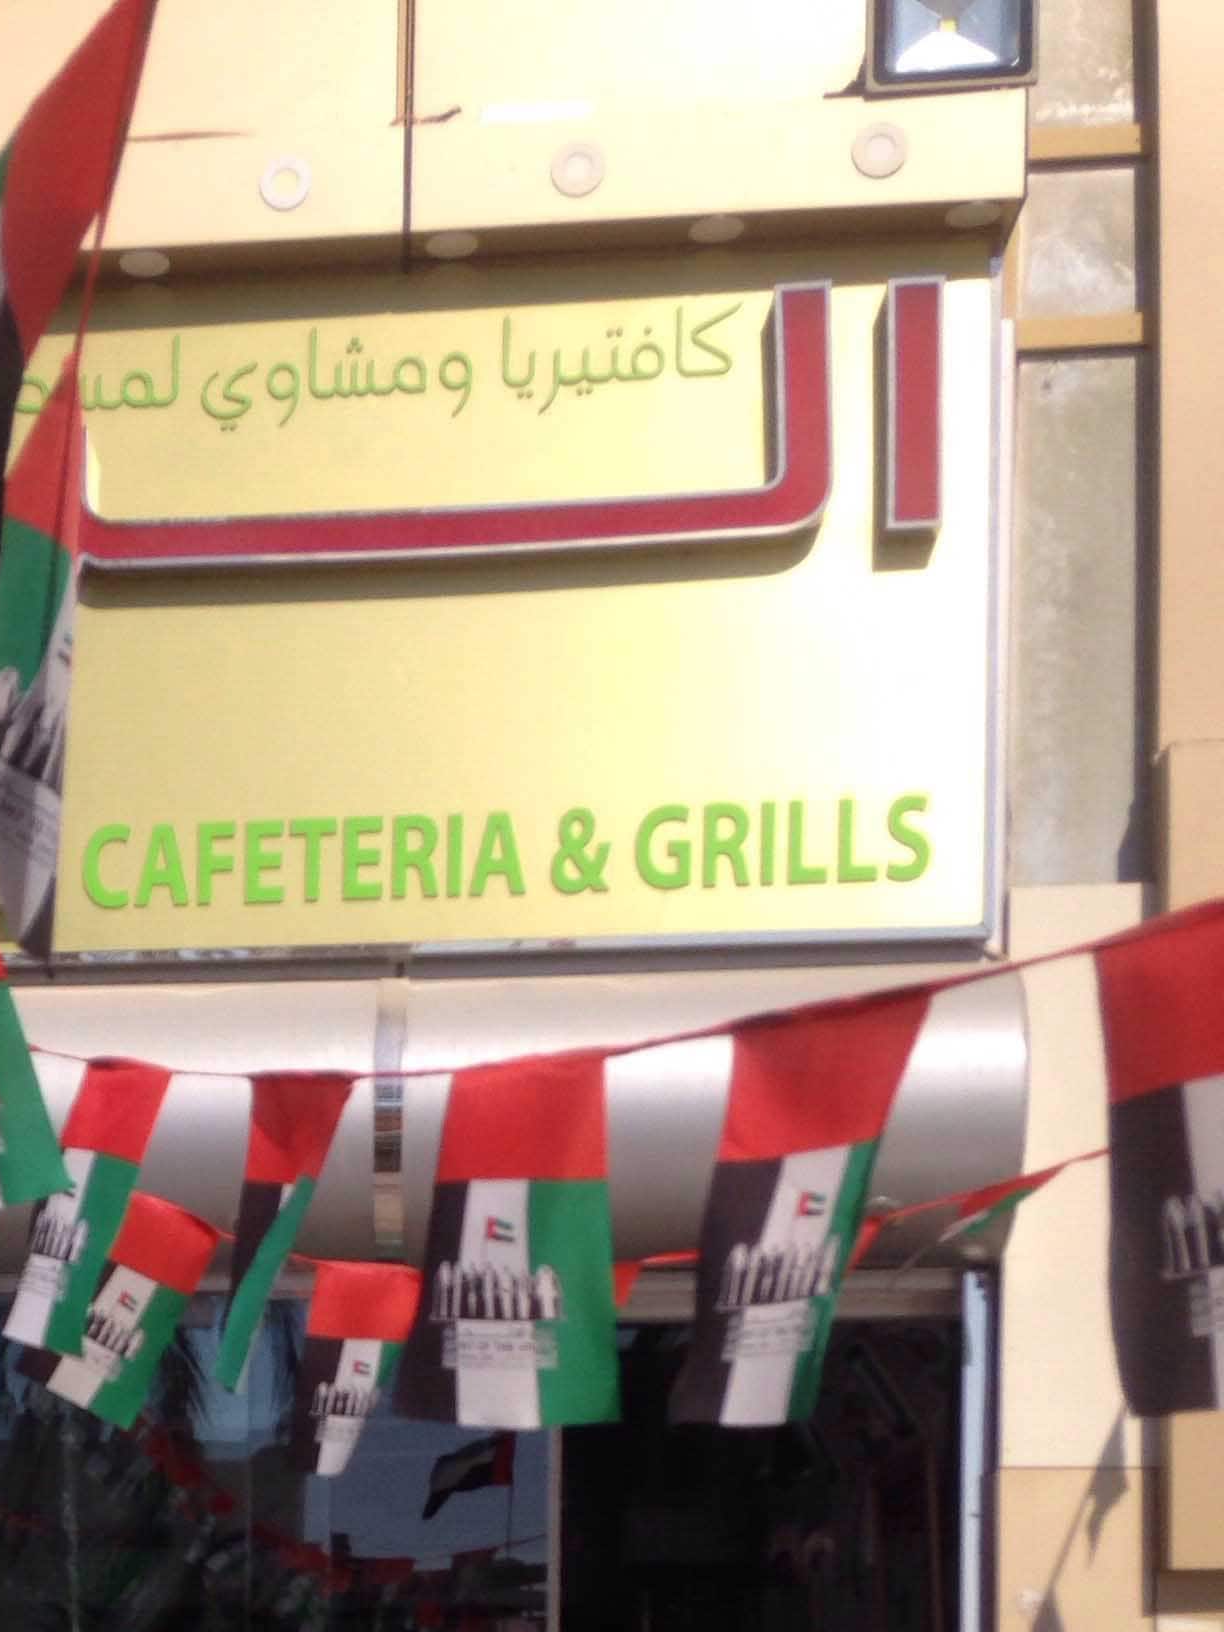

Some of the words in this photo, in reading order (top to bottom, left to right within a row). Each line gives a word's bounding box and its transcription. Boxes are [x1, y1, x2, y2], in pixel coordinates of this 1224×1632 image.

[501, 301, 743, 416] كافتيريا
[82, 811, 526, 908] CAFETERIA
[550, 806, 611, 896] &
[635, 795, 932, 891] GRILLS
